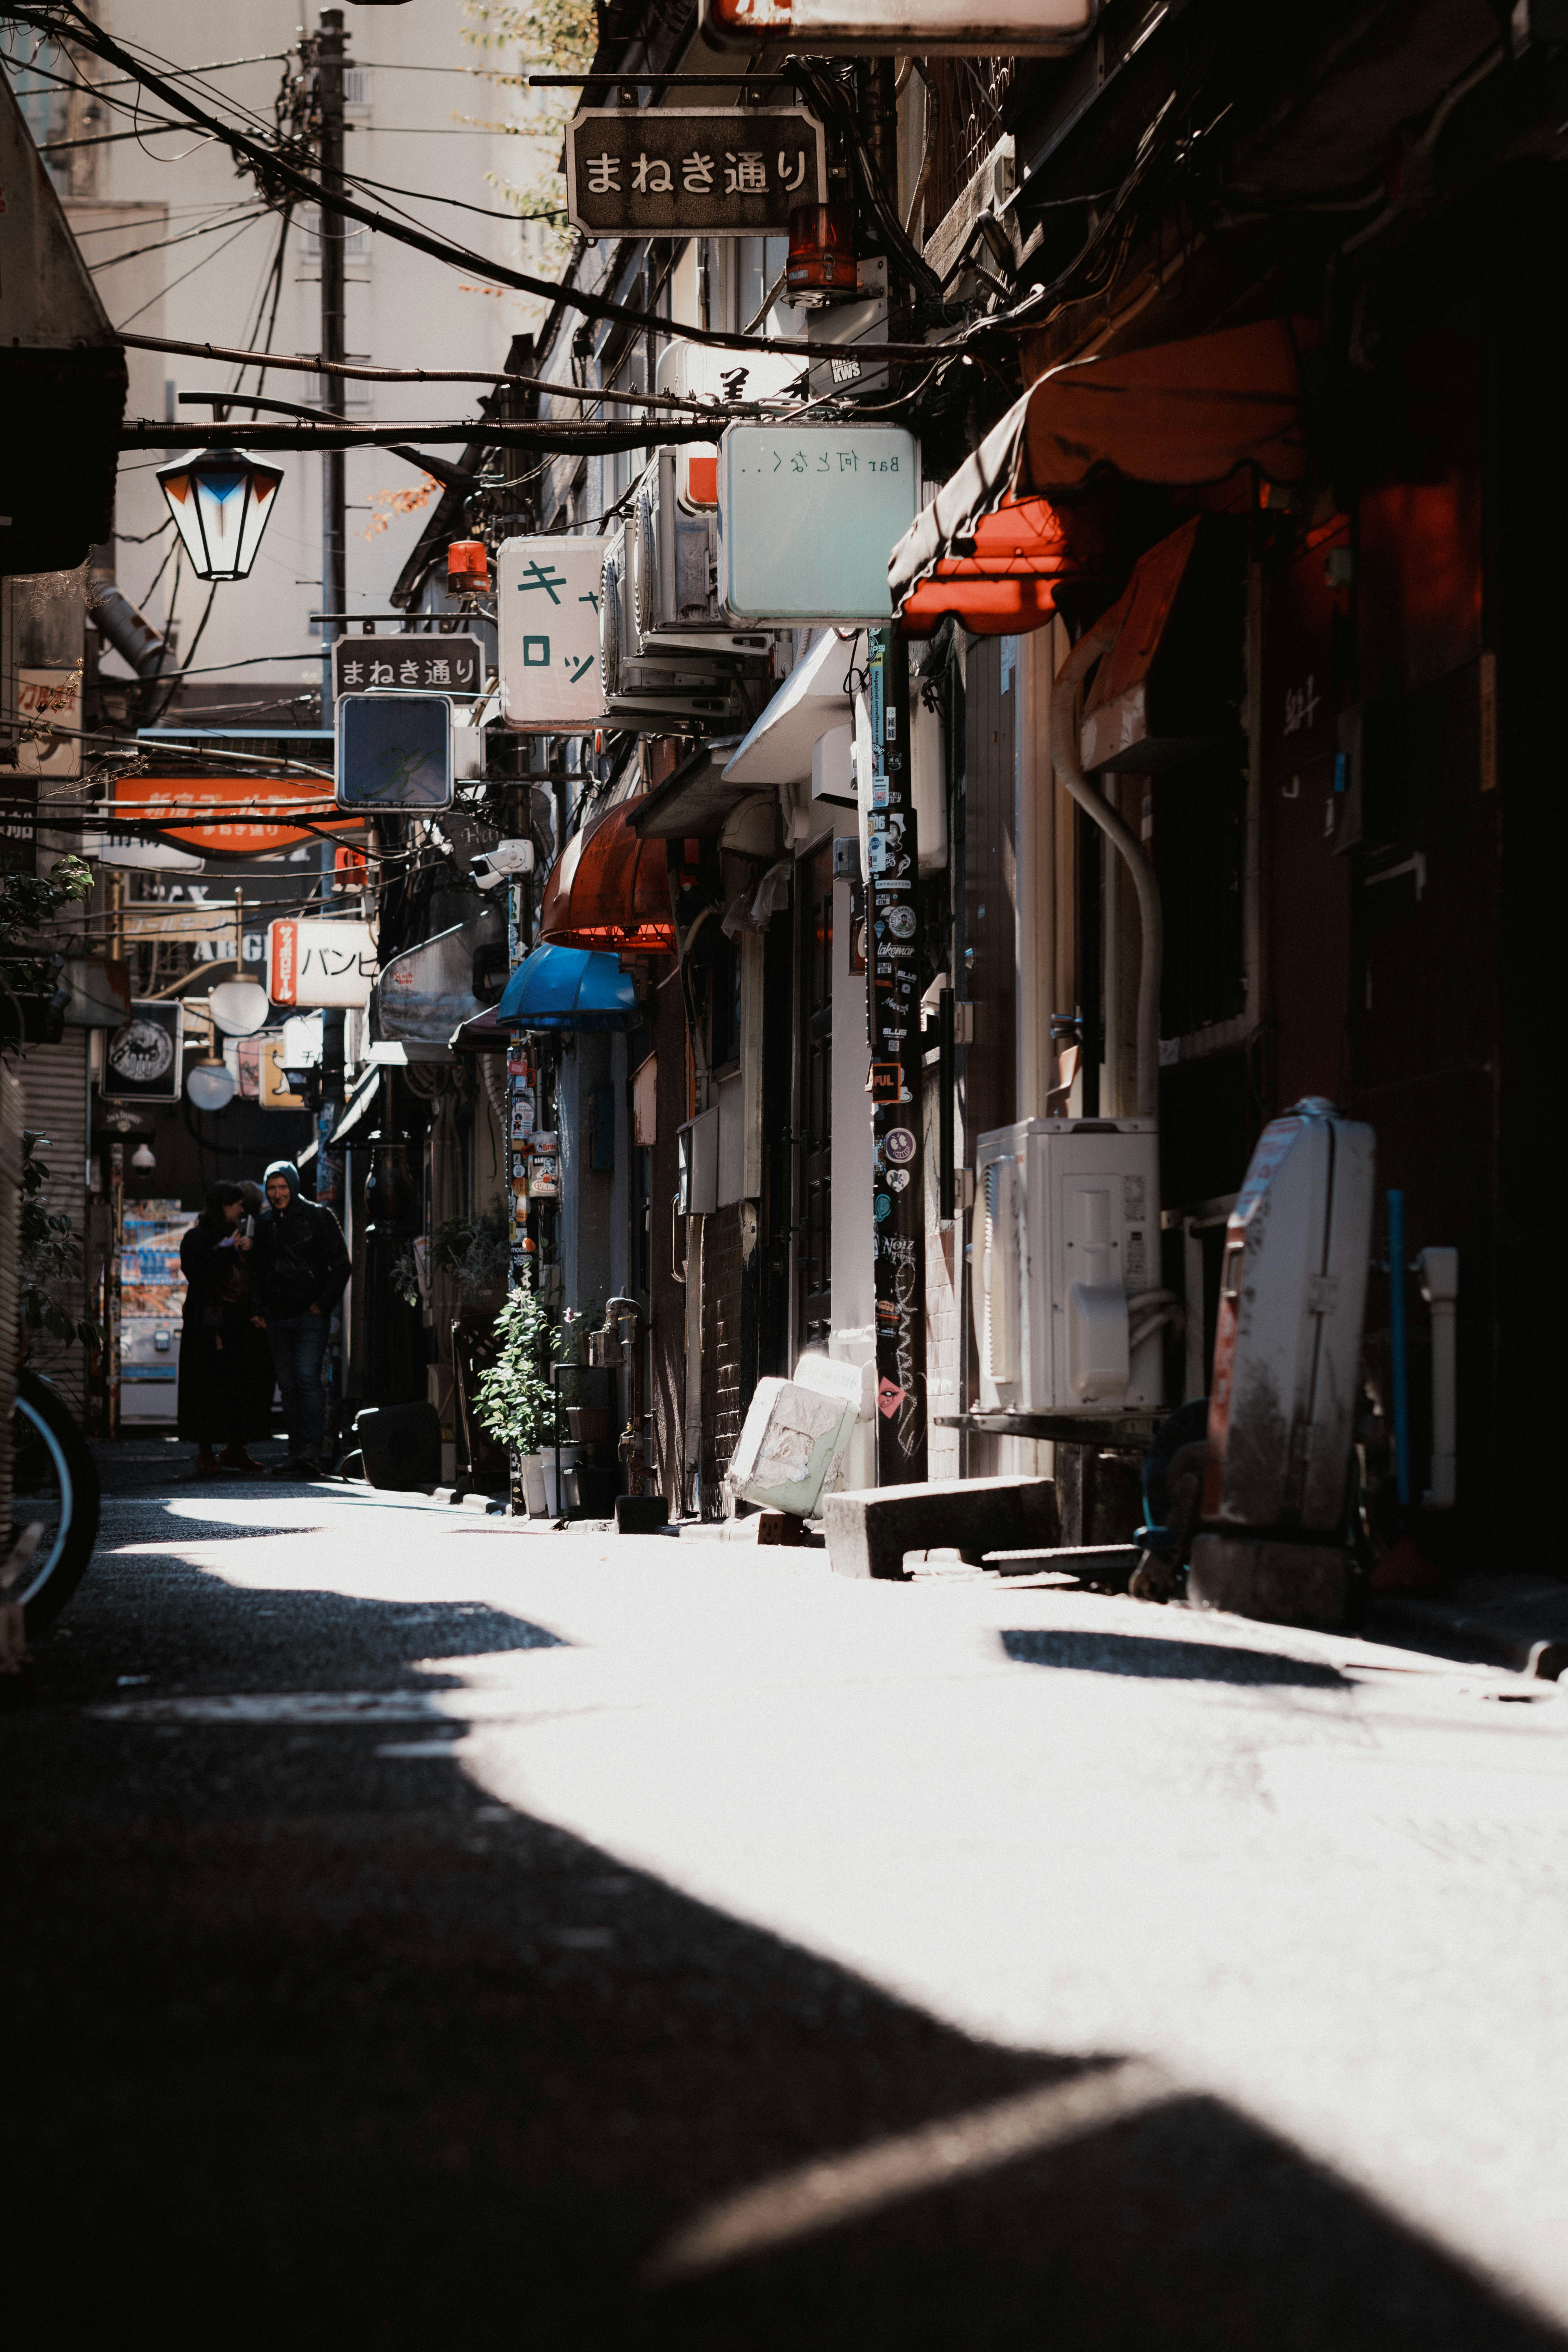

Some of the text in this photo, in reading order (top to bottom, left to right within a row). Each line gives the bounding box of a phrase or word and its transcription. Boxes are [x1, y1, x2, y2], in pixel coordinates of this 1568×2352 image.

[586, 151, 805, 194] まねき通り
[833, 362, 860, 383] KWS
[343, 659, 474, 685] まねき通り
[873, 1075, 894, 1087] FUL
